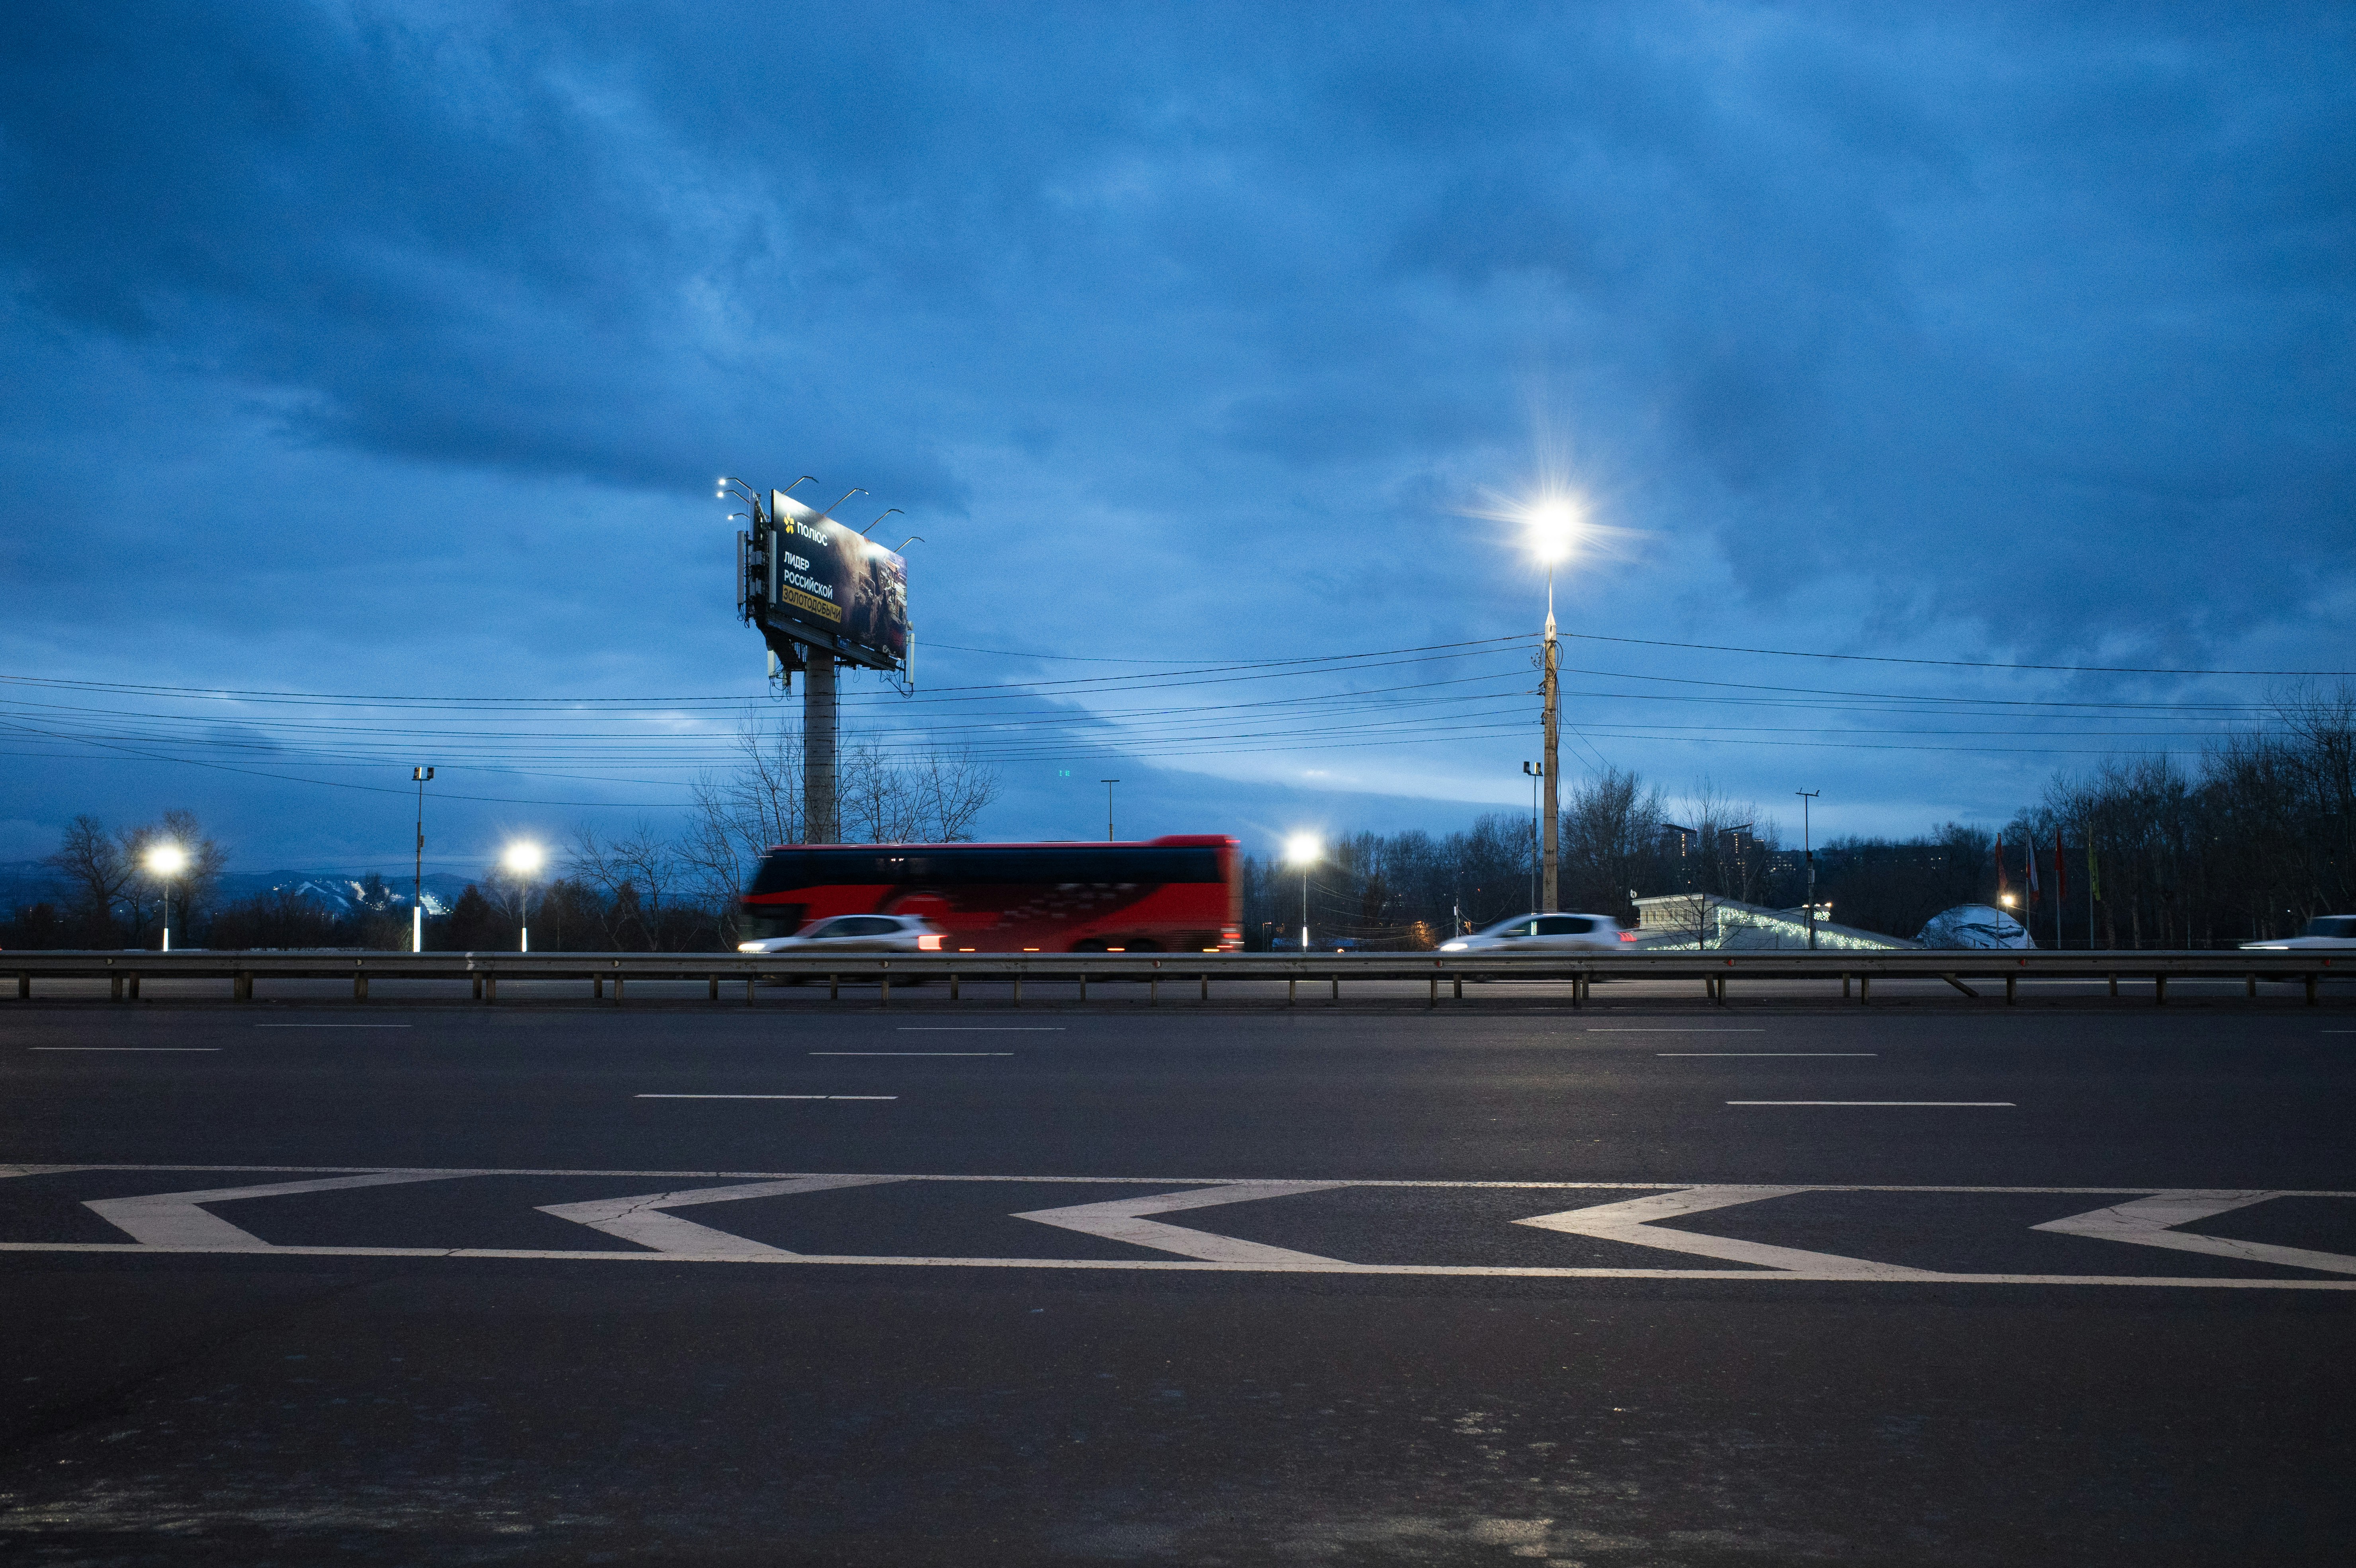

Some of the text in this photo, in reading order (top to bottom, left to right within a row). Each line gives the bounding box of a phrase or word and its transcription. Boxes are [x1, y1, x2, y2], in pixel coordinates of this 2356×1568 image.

[797, 521, 828, 547] ПОЛЮС
[784, 551, 809, 571] ЛИДЕР
[784, 569, 833, 599] РОССИЙСКОЙ
[783, 588, 841, 621] ЗОЛОТОДОБЫЧИ
